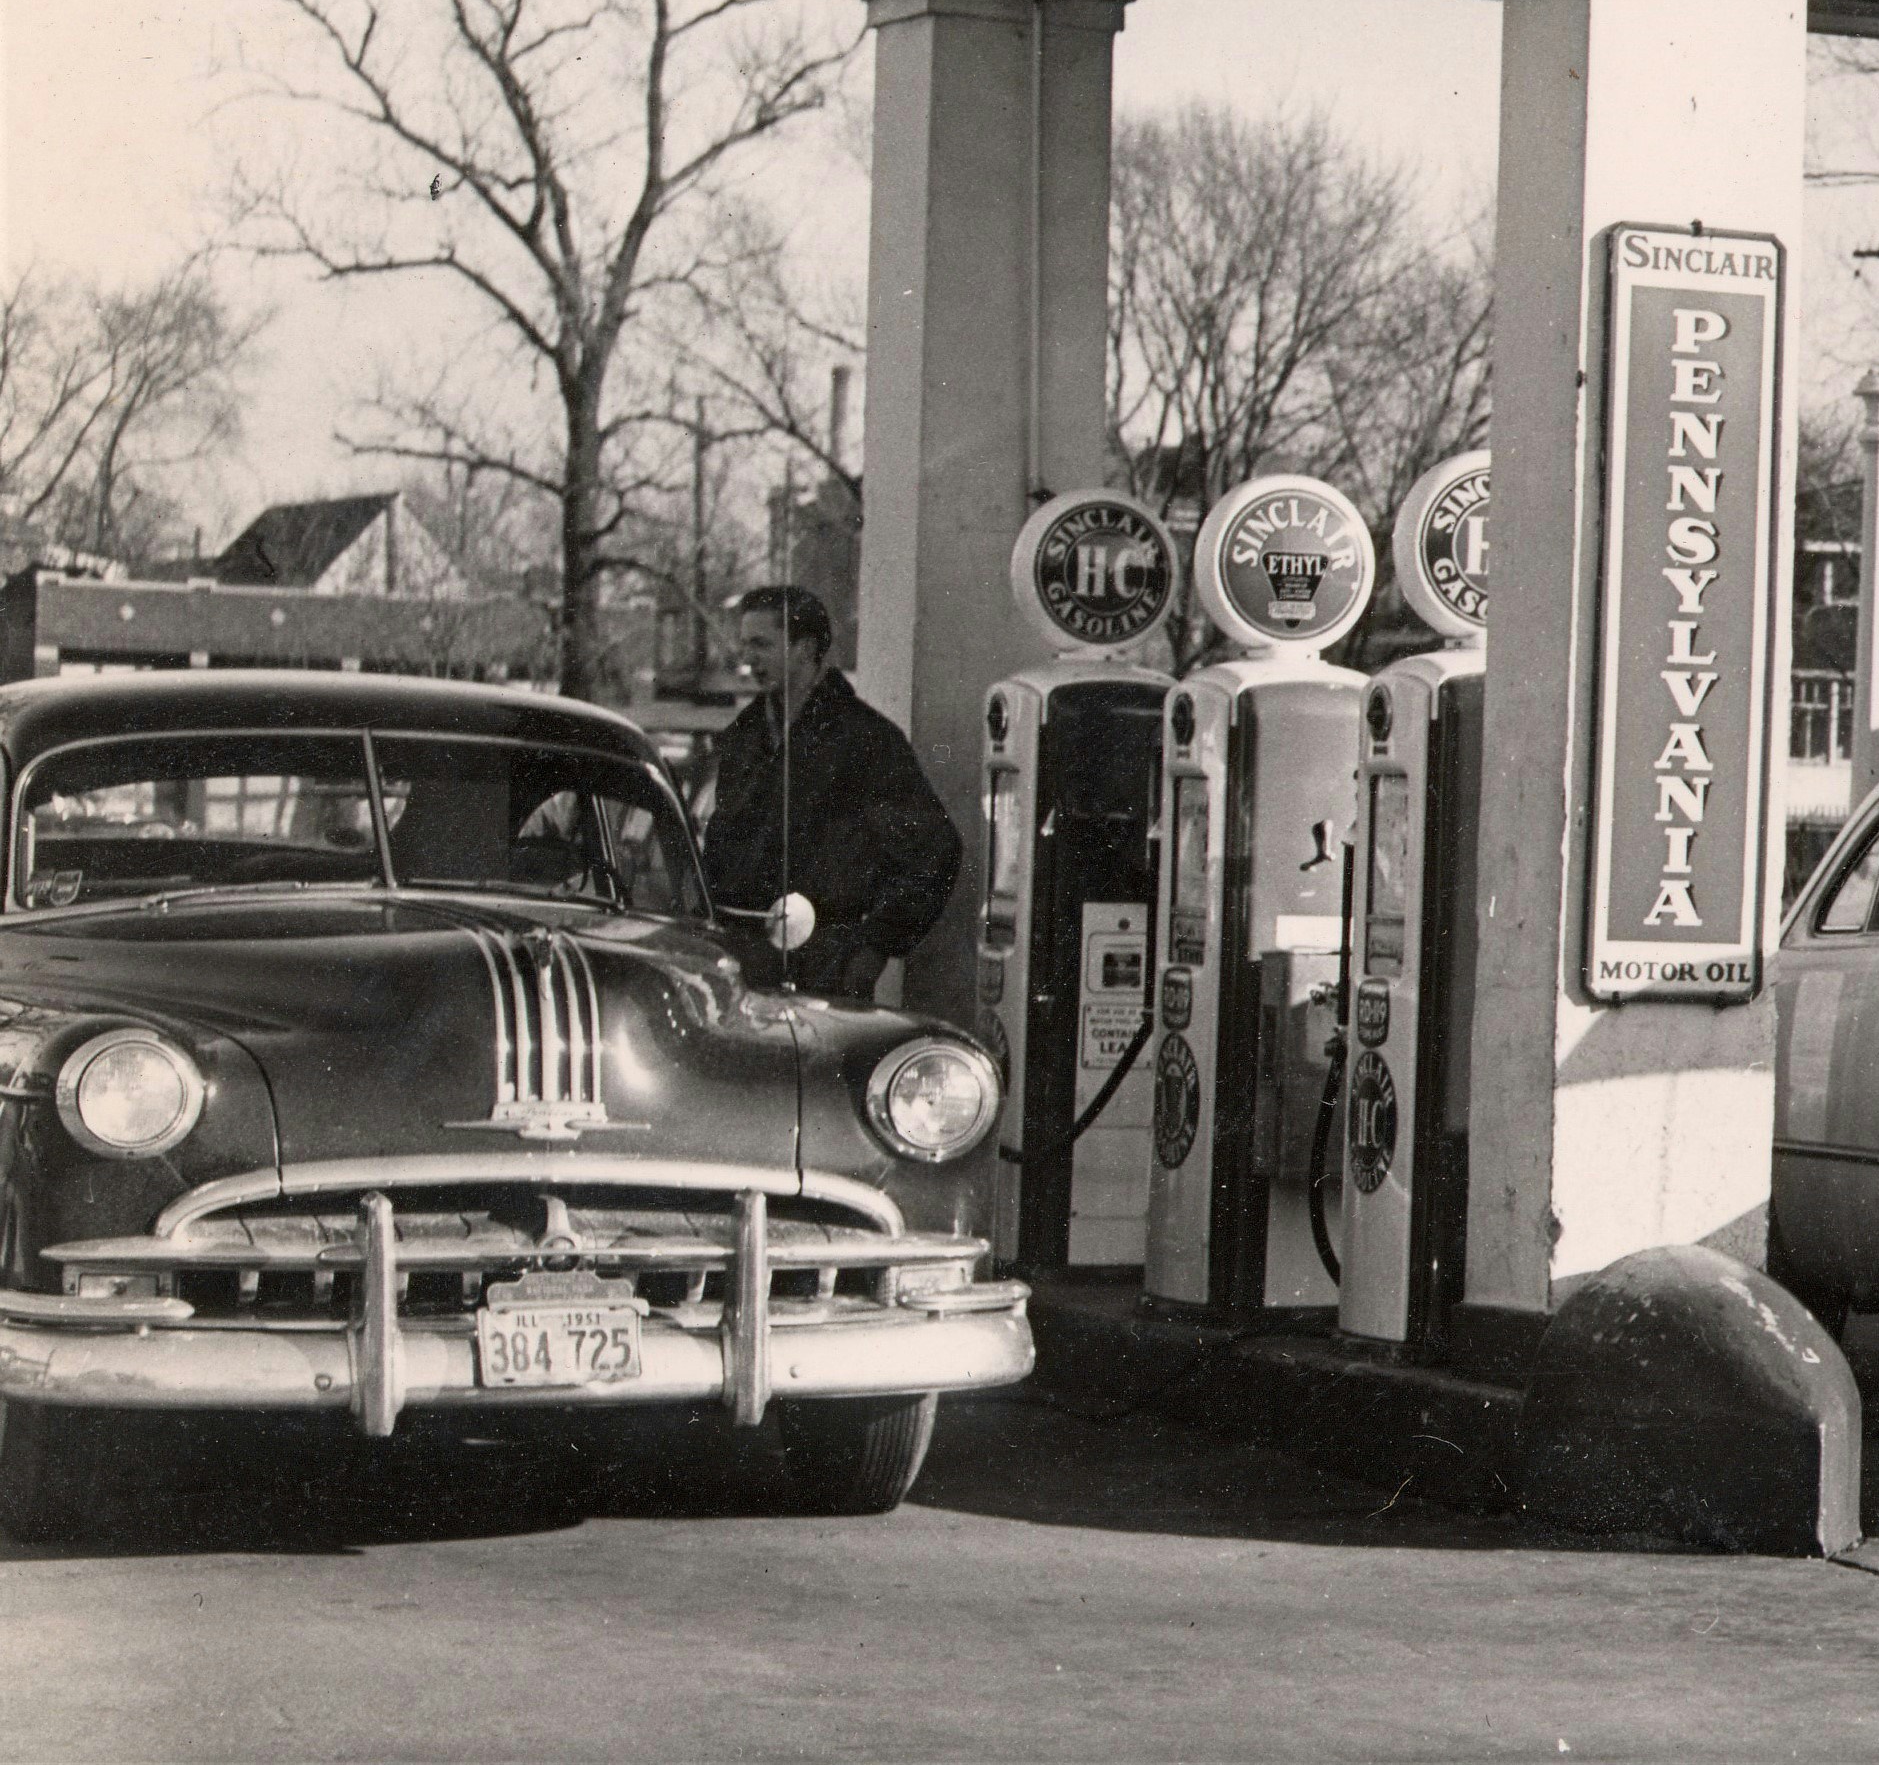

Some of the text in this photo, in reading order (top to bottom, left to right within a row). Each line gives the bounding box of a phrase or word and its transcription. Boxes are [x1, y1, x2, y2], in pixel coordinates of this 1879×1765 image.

[1623, 235, 1776, 280] SINCLAIR
[1047, 509, 1160, 568] SINCLAIR
[1232, 498, 1356, 572] SINCLAIR
[1267, 554, 1325, 576] ETHYL
[1048, 582, 1160, 636] GASOLINE
[1643, 308, 1729, 927] PENNSYLVANIA
[1600, 961, 1751, 983] MOTOR OIL
[516, 1312, 601, 1328] ILL 1951
[489, 1327, 631, 1374] 384 725
